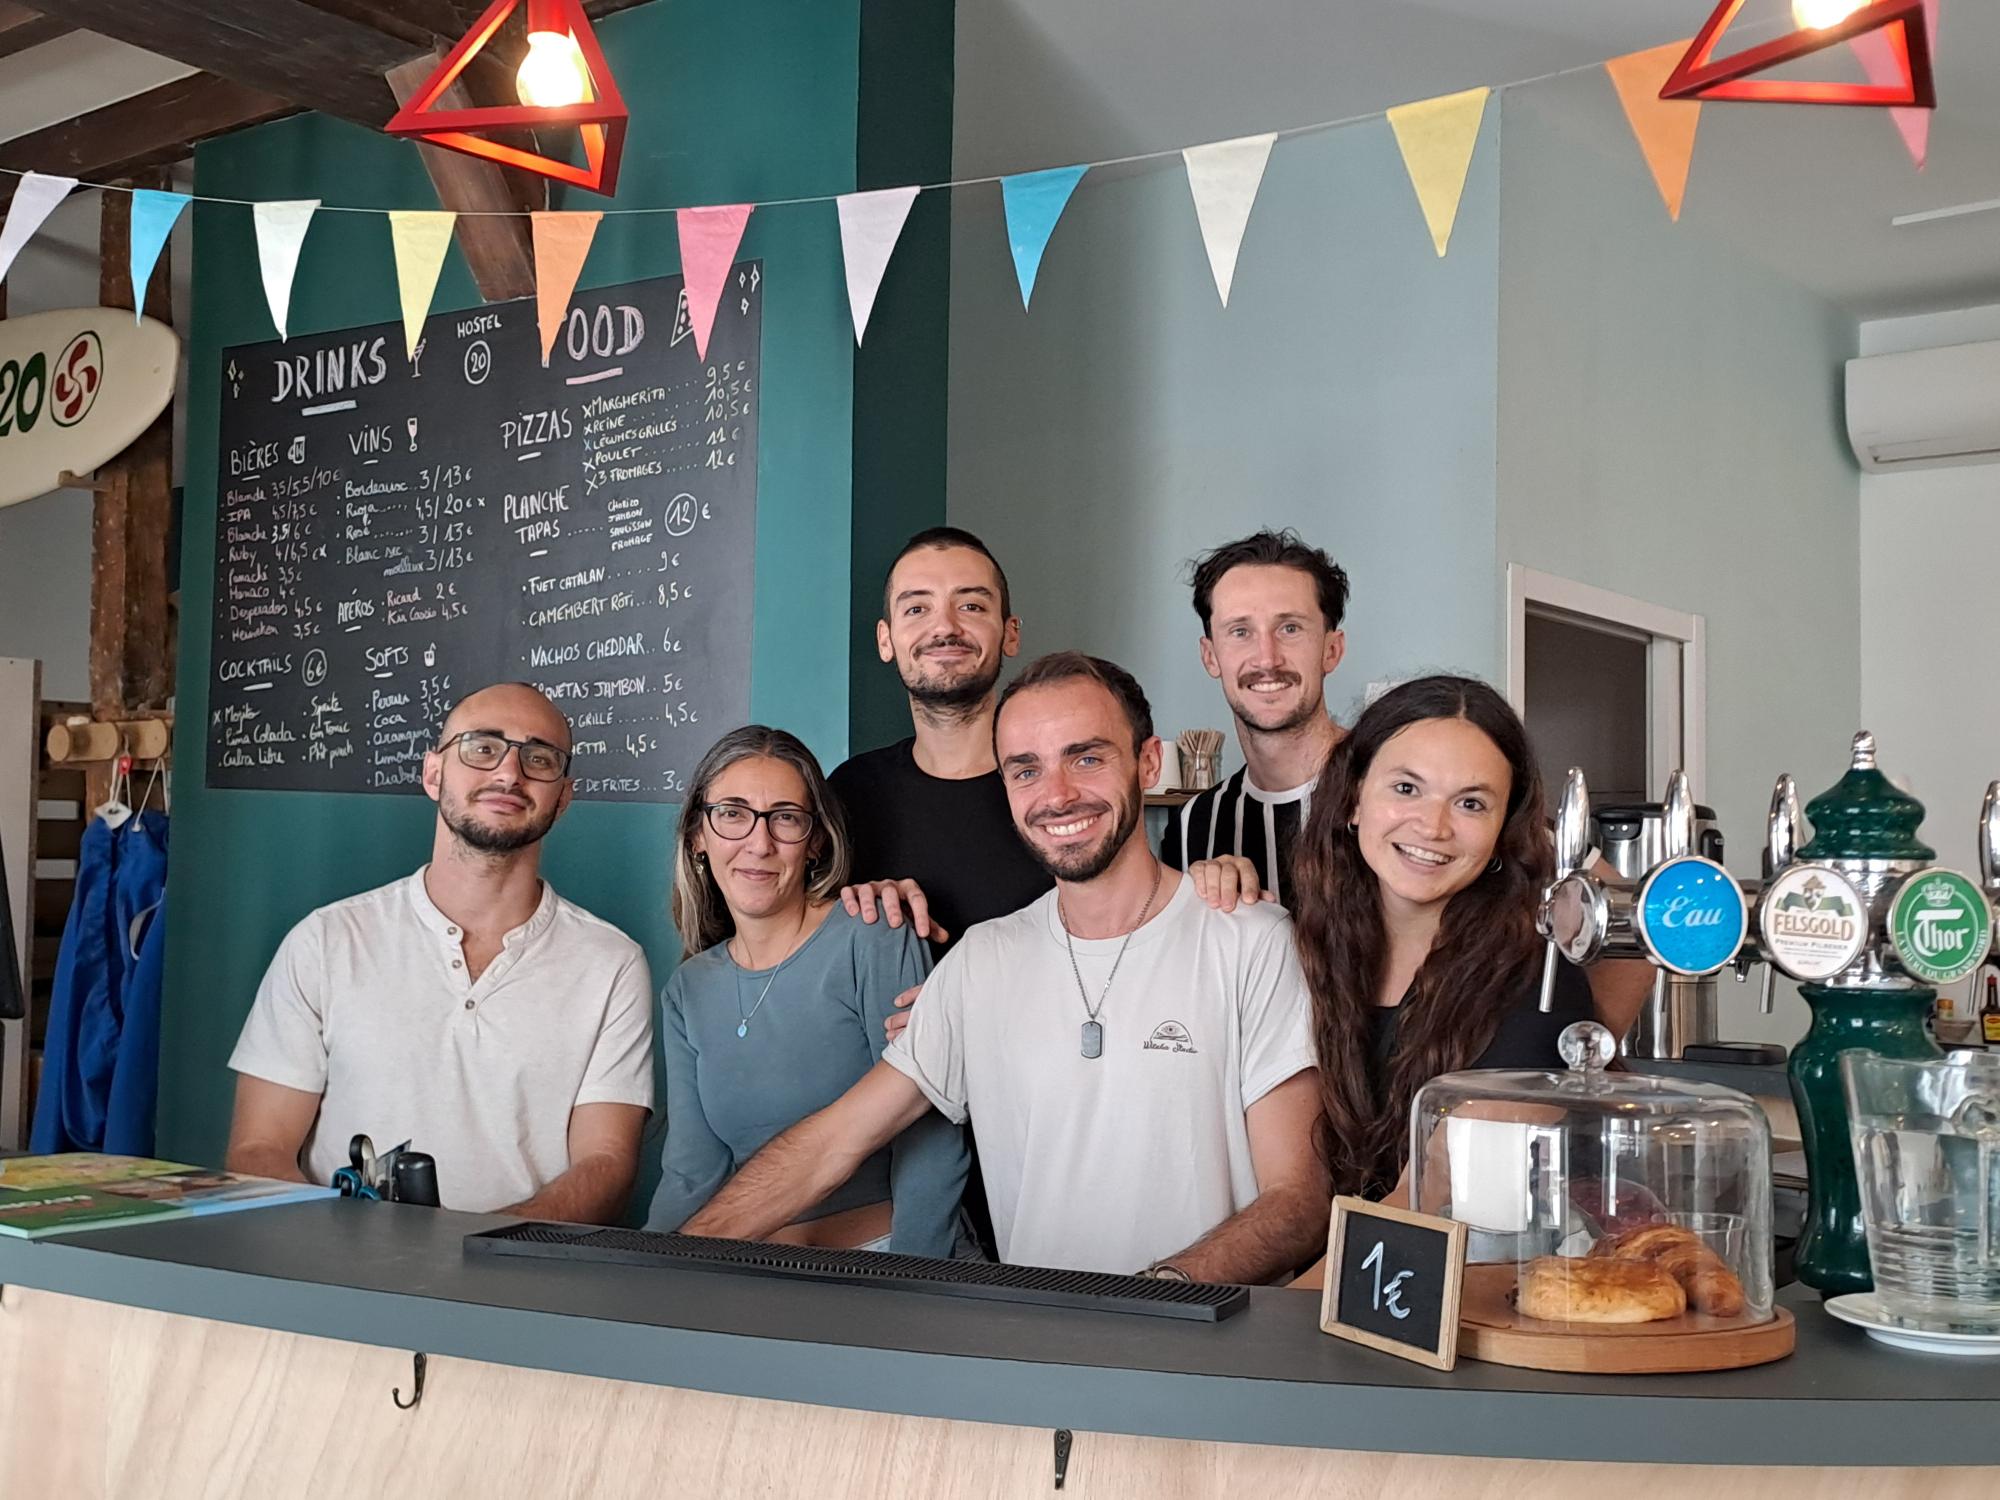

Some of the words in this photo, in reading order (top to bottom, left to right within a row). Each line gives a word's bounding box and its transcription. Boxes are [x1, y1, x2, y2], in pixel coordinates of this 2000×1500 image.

[457, 313, 502, 339] HOSTEL
[271, 336, 387, 402] DRINKS
[348, 424, 393, 456] VINS
[500, 408, 573, 450] PIZZAS
[231, 440, 279, 476] BIÈRES
[595, 446, 643, 466] POULET
[610, 461, 663, 483] FROMAGES
[345, 479, 408, 499] Bordeaux
[226, 508, 251, 523] IPA
[504, 485, 570, 524] PLANCHE
[515, 520, 561, 545] TAPAS
[611, 533, 654, 551] FROMAGE
[346, 545, 381, 565] Blanc
[528, 576, 556, 595] FUET
[559, 567, 605, 590] CATALAN
[387, 586, 422, 608] Ricard
[528, 597, 609, 627] CAMEMBERT
[364, 646, 409, 671] SOFTS
[531, 645, 580, 668] NACHOS
[586, 632, 646, 661] CHEDDAR
[219, 653, 293, 682] COCKTAILS
[594, 674, 645, 698] JAMBON
[373, 714, 408, 728] Coca
[578, 705, 614, 729] GRILLÉ
[253, 721, 297, 744] Colada
[1662, 895, 1726, 928] Eau
[1774, 913, 1855, 941] FELSGOLD
[1913, 908, 1970, 957] Thor
